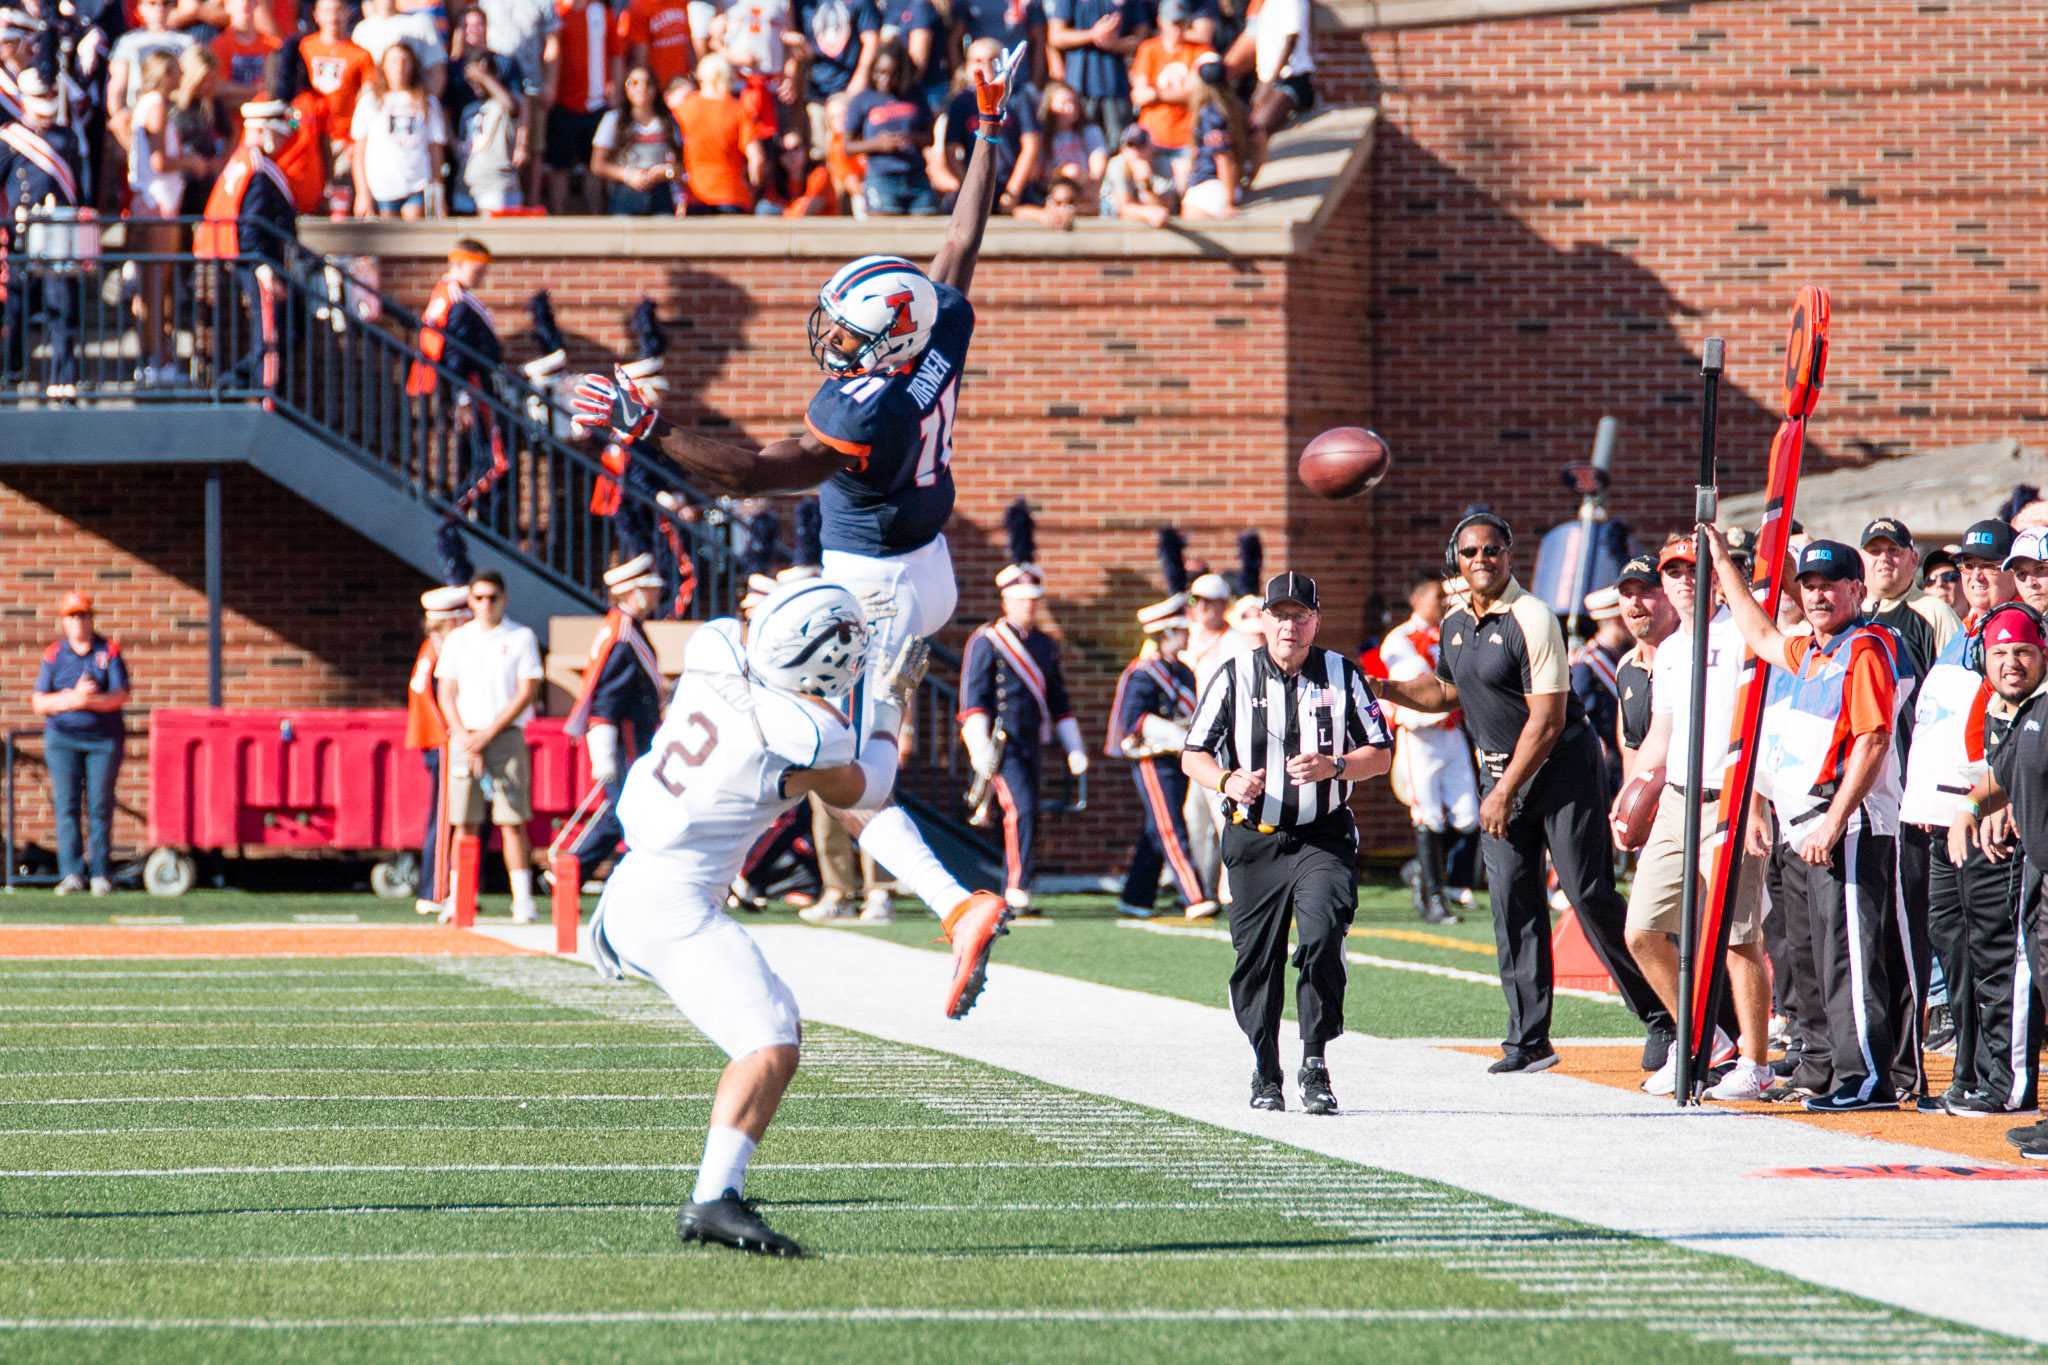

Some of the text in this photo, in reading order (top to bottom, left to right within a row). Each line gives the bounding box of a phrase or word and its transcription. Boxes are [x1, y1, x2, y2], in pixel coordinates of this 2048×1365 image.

[839, 375, 887, 405] 11
[906, 347, 953, 411] TURNER
[652, 710, 719, 798] 2
[1319, 728, 1333, 746] L
